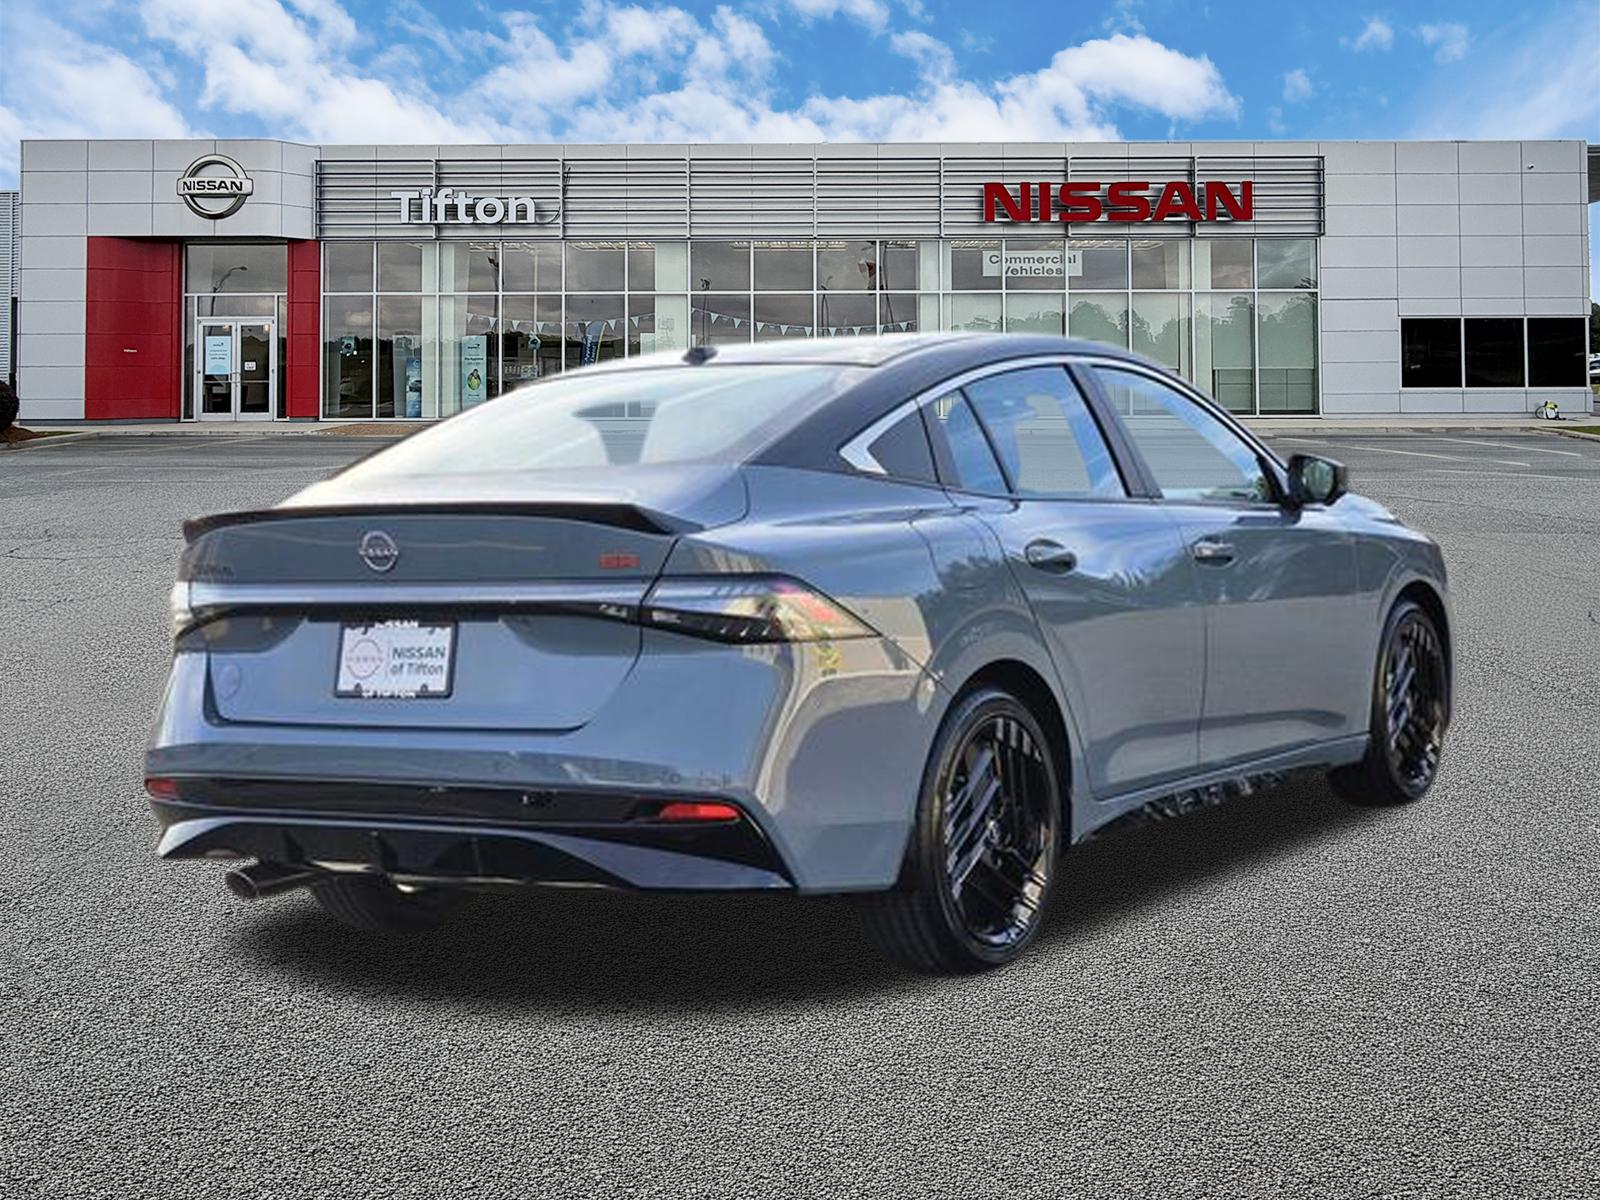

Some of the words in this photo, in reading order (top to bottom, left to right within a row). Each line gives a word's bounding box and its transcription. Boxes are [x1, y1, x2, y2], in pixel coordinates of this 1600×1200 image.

[182, 180, 243, 191] NISSAN
[390, 187, 536, 224] Tifton
[982, 180, 1254, 223] NISSAN
[391, 646, 447, 660] NISSAN
[389, 663, 404, 676] of
[407, 662, 444, 676] Tifton
